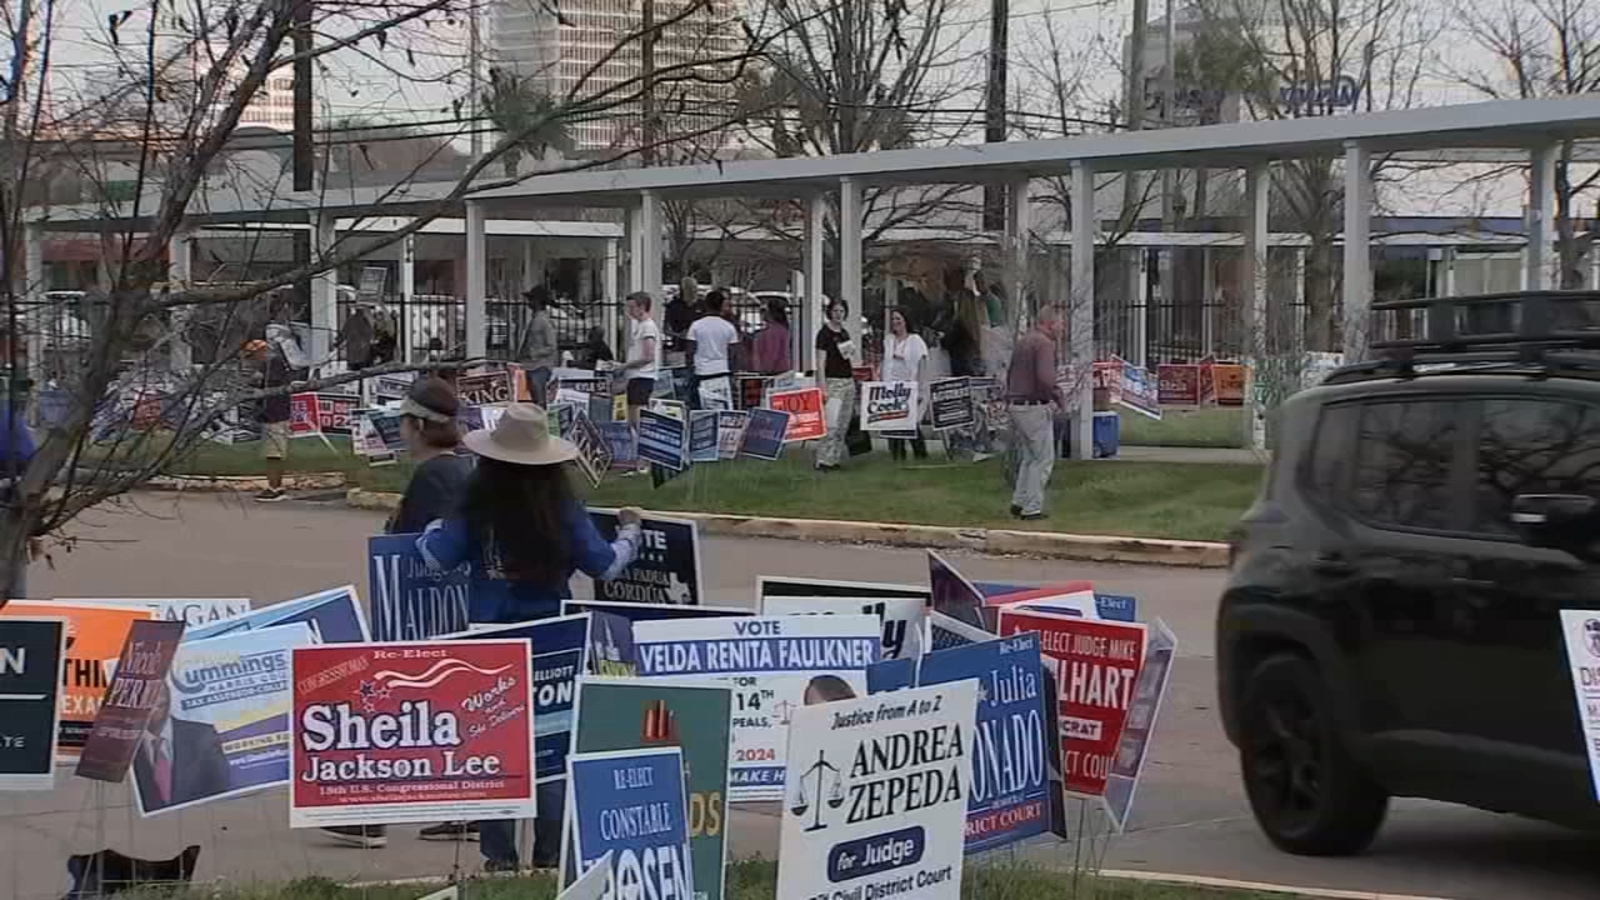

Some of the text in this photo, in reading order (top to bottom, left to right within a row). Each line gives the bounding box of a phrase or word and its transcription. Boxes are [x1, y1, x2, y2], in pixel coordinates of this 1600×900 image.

[461, 386, 509, 405] KING
[869, 383, 911, 401] Molly
[734, 621, 781, 635] VOTE
[374, 649, 448, 660] Re-Elect
[639, 644, 701, 673] VELDA
[706, 641, 772, 670] RENITA
[778, 639, 873, 668] FAULKNER
[1071, 631, 1107, 658] JUDGE
[1109, 639, 1137, 662] MIKE
[534, 664, 574, 682] ELLIOTT
[989, 666, 1037, 708] Julia
[461, 677, 516, 712] Works
[302, 700, 462, 752] Sheila
[831, 695, 943, 731] Justice from A to Z
[1062, 720, 1098, 736] CRAT
[302, 752, 432, 782] Jackson
[443, 750, 501, 776] Lee
[735, 749, 775, 761] 2024
[850, 721, 964, 779] ANDREA
[319, 779, 505, 796] 18th U.S. Congressional District
[613, 766, 655, 790] RE-ELECT
[845, 764, 962, 825] ZEPEDA
[600, 802, 673, 841] CONSTABLE
[999, 802, 1042, 827] COURT
[836, 837, 915, 872] for Judge
[584, 842, 693, 900] OSEN
[865, 876, 914, 900] District
[916, 865, 953, 888] Court
